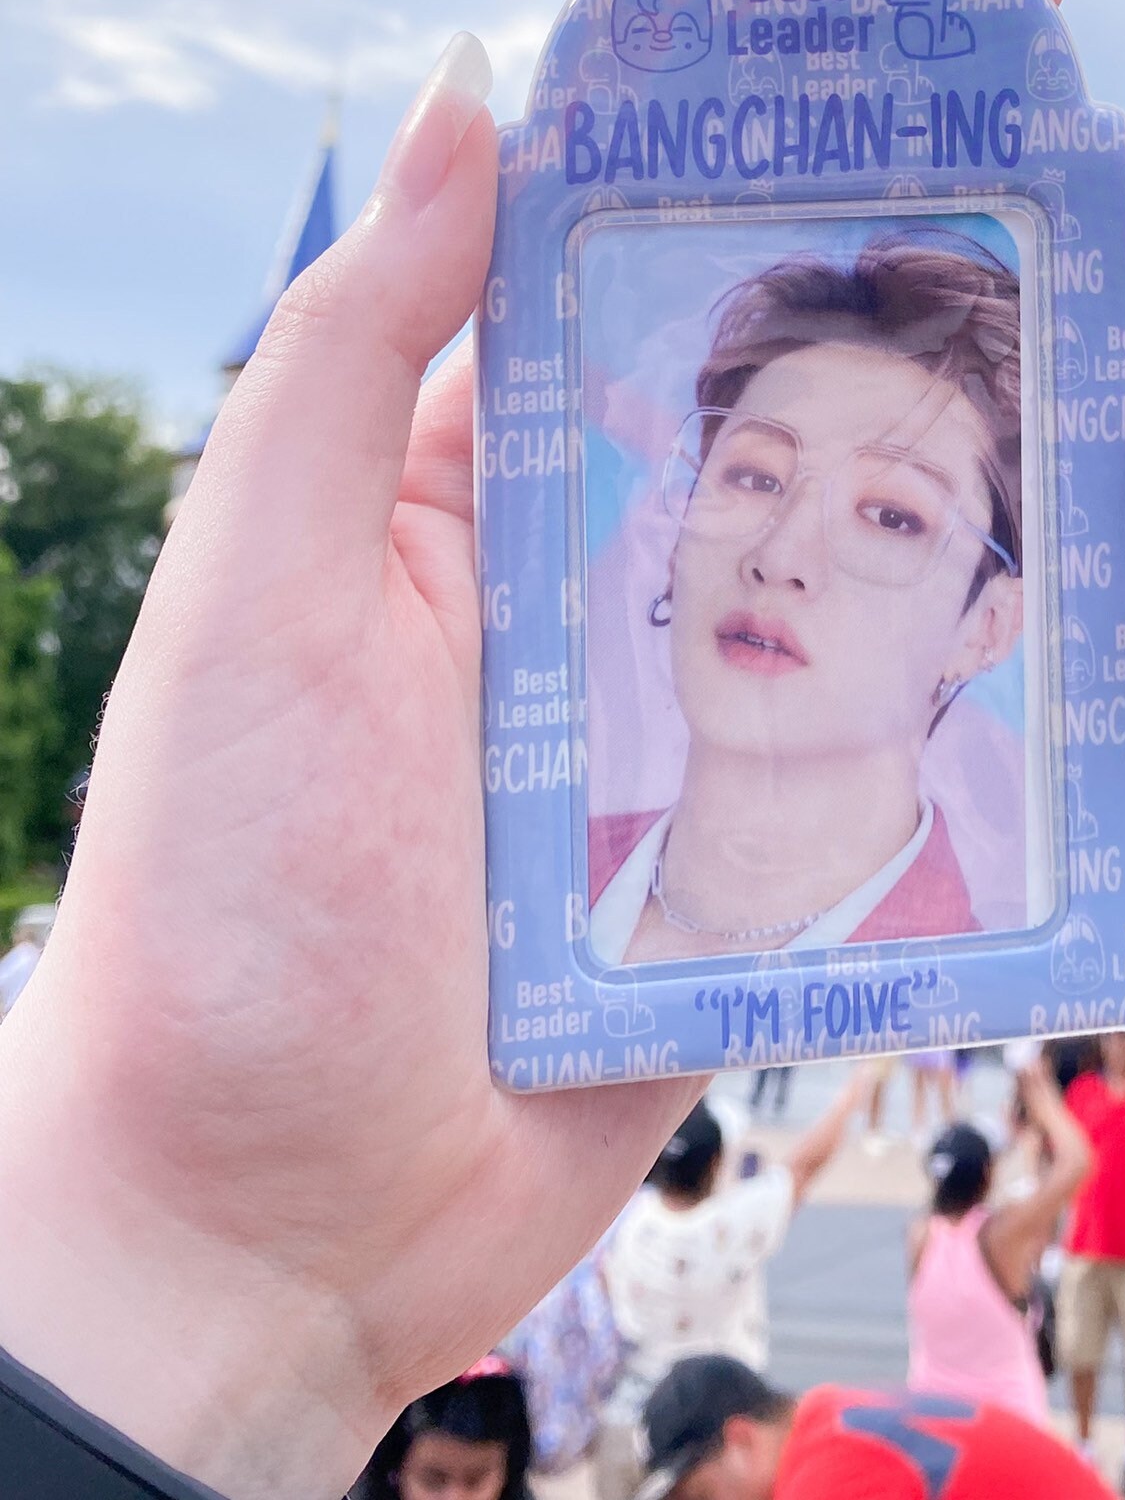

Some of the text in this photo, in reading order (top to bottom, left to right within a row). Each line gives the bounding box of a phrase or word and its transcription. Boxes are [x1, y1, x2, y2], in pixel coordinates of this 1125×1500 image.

[727, 6, 875, 56] Leader
[564, 88, 1022, 186] BANGCHAN-ING
[1053, 248, 1104, 295] ING
[507, 352, 565, 384] Best
[493, 382, 583, 416] Leader
[1061, 542, 1113, 591] ING
[513, 662, 569, 696] Best
[1068, 844, 1122, 896] ING
[516, 973, 576, 1009] Best
[500, 1006, 593, 1044] Leader
